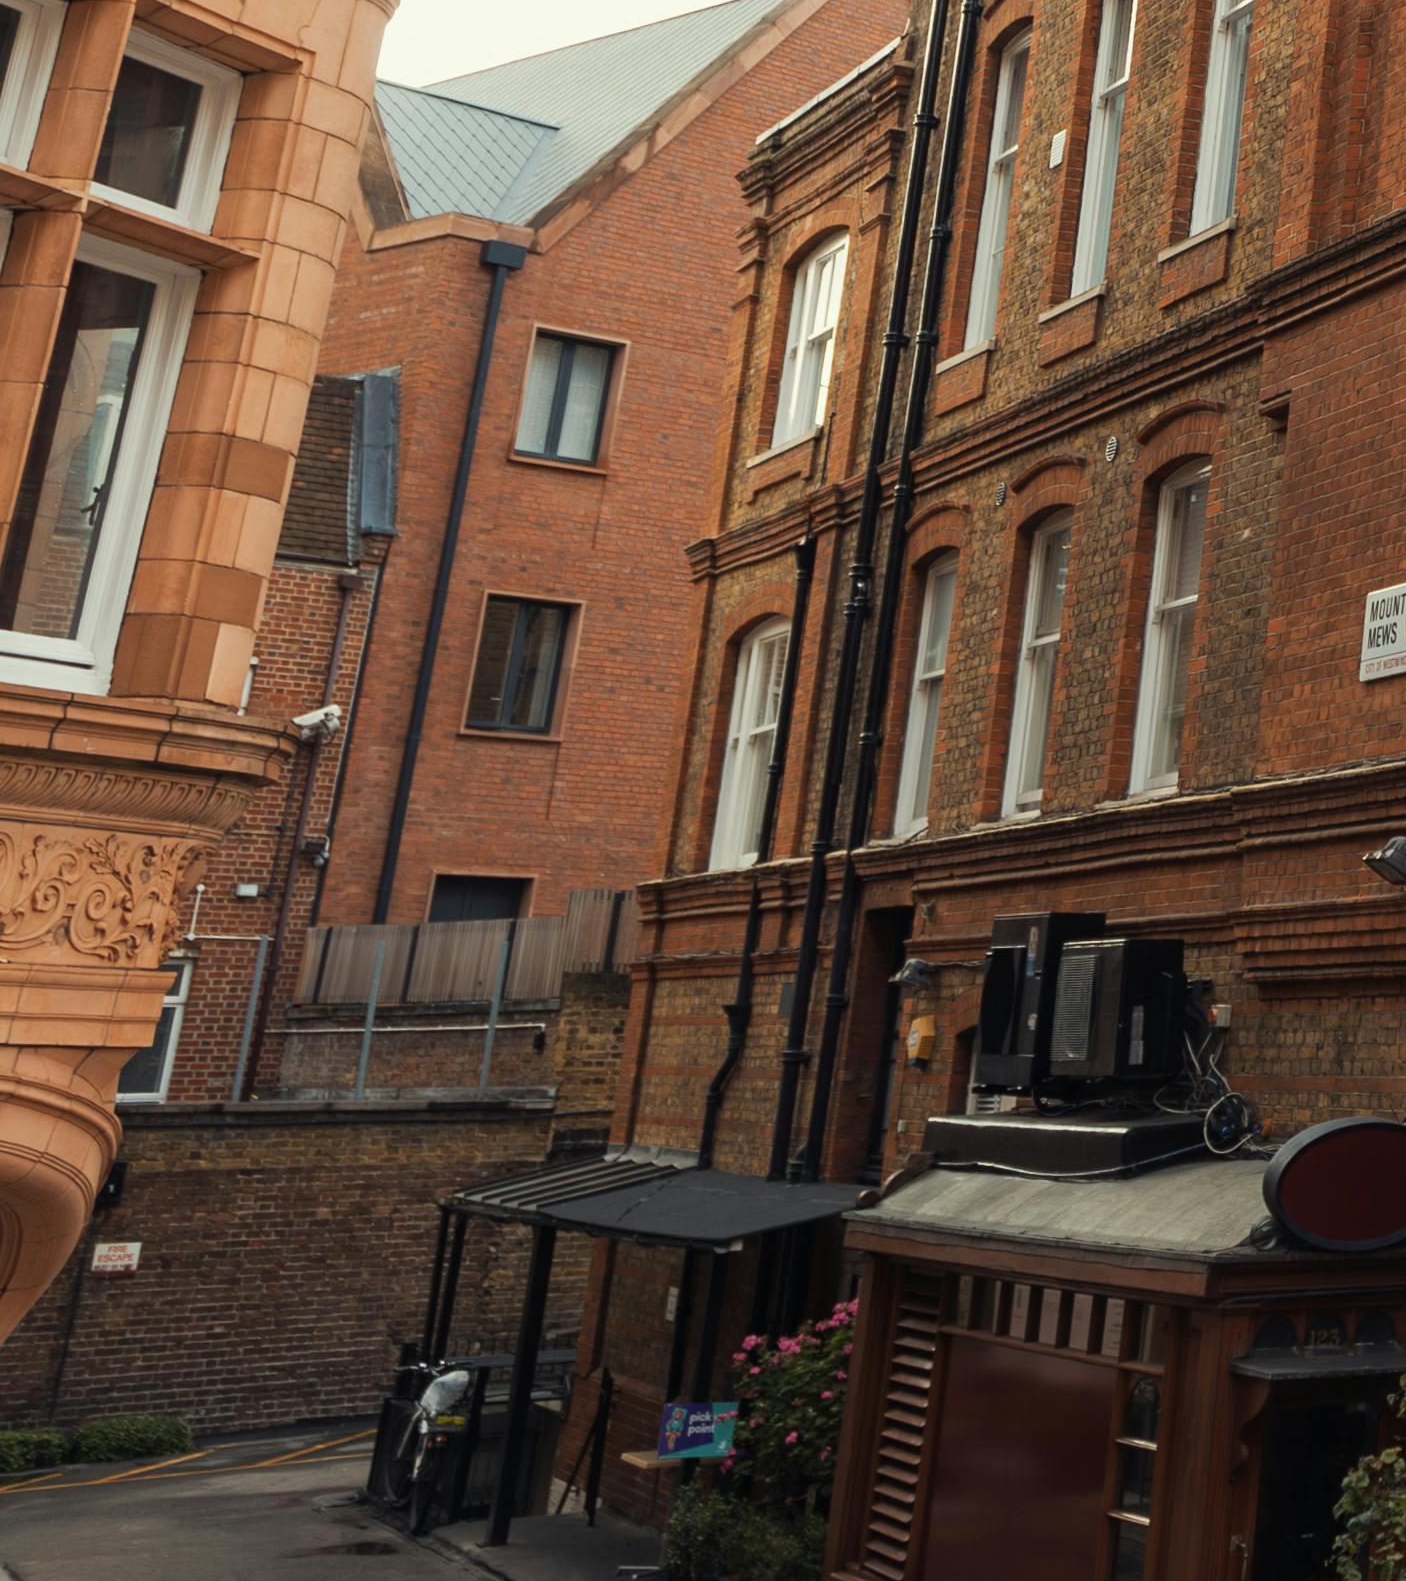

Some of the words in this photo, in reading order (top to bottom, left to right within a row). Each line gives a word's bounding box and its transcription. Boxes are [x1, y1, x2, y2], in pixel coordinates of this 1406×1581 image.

[1370, 593, 1406, 622] MOUNT
[1367, 622, 1398, 649] MEWS
[689, 1411, 711, 1425] pick
[688, 1423, 715, 1437] point
